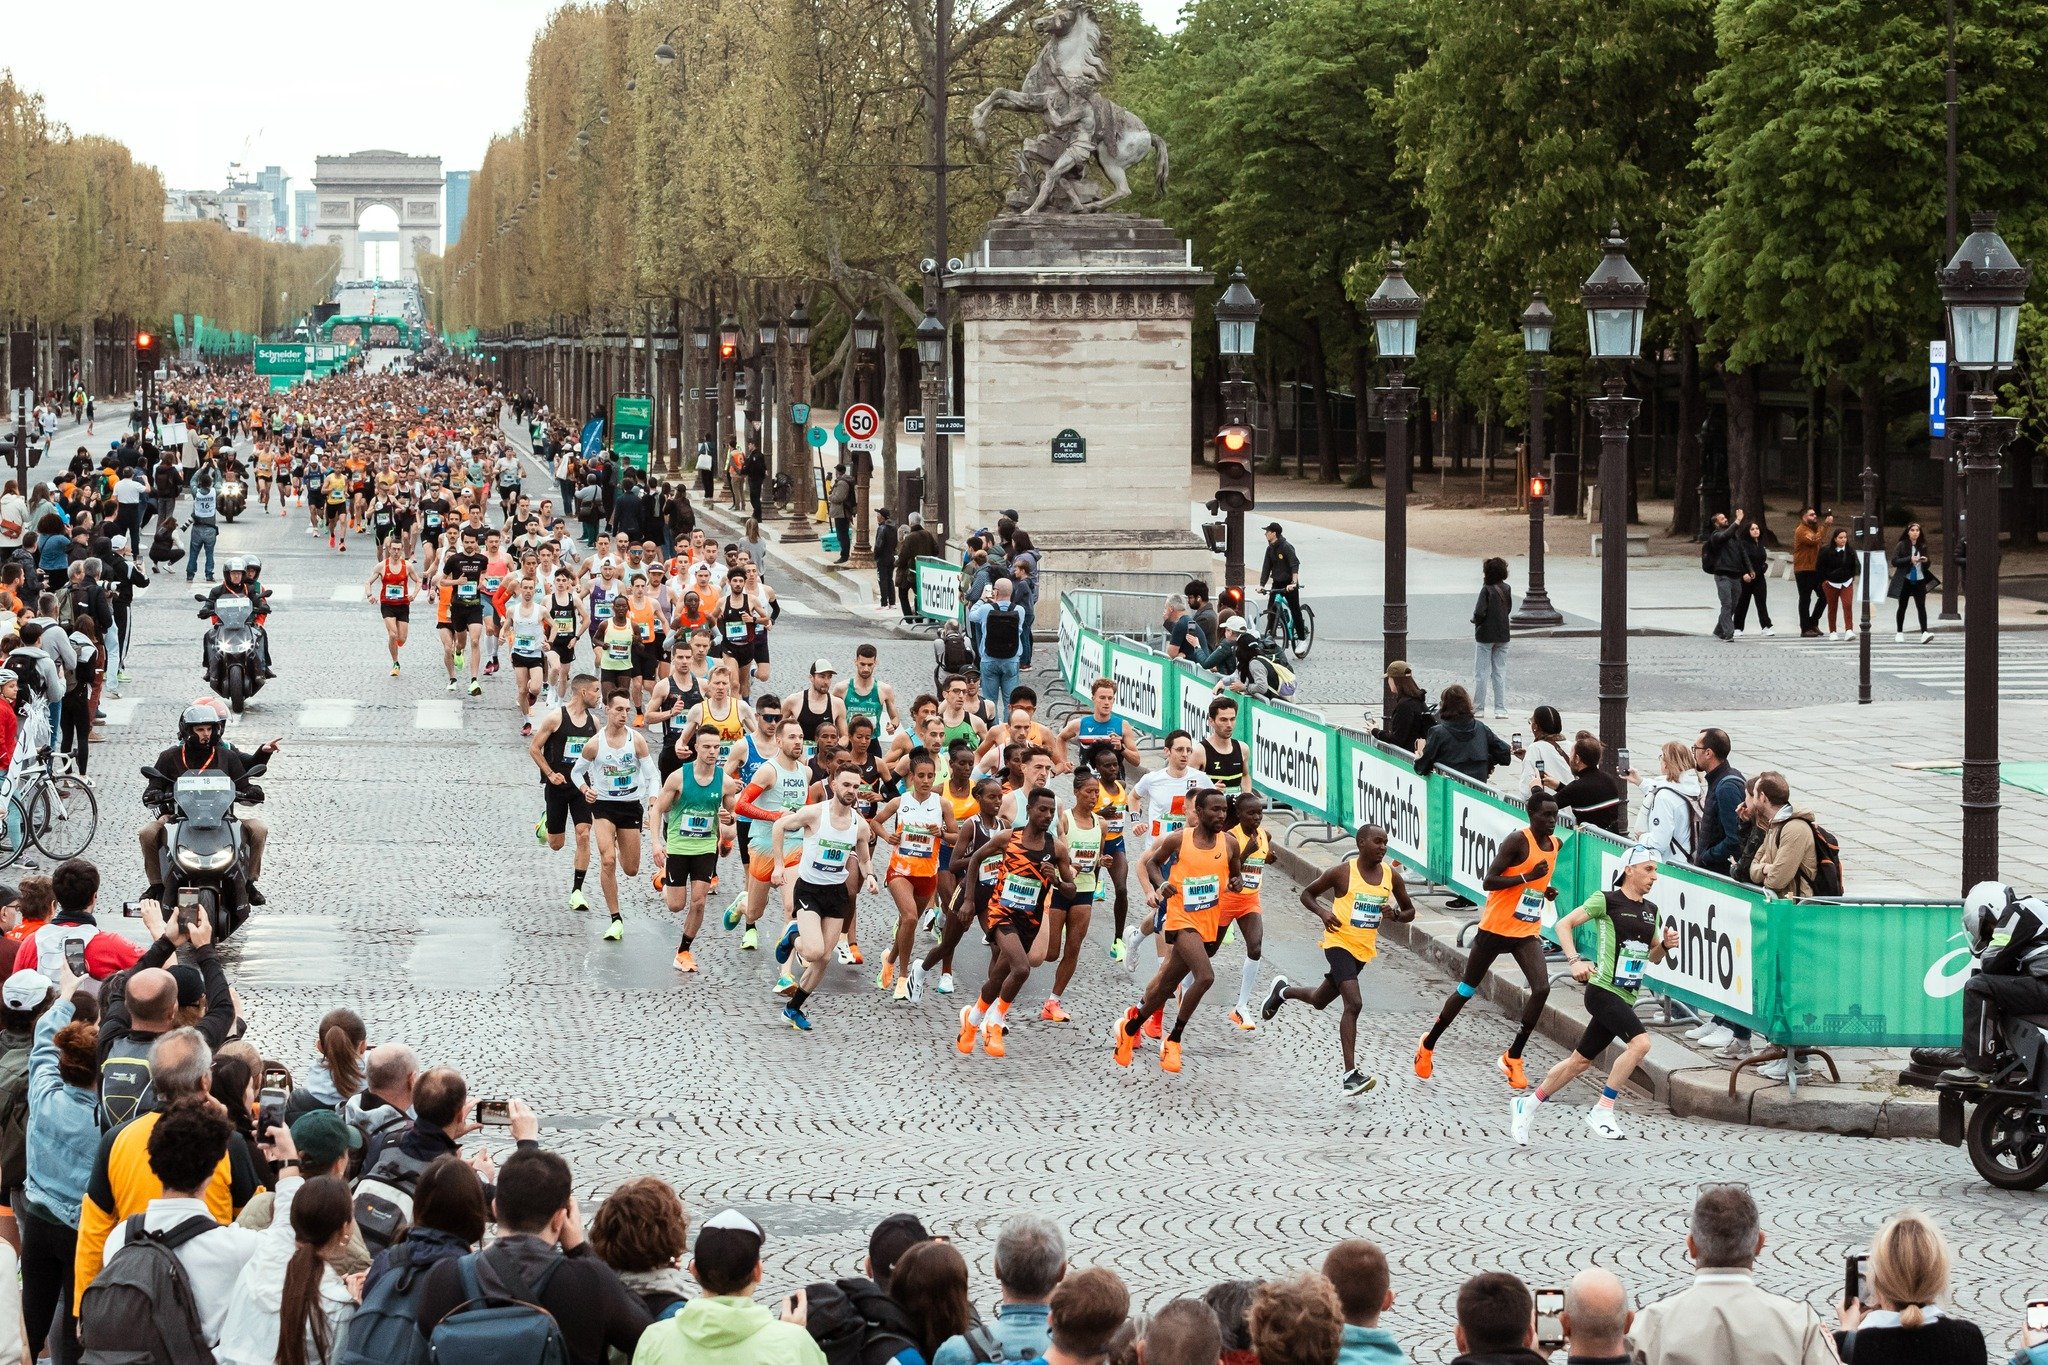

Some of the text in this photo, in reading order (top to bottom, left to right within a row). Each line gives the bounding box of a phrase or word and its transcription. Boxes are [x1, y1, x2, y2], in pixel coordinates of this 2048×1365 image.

[259, 349, 301, 363] Schneider
[1930, 367, 1940, 415] P
[852, 415, 872, 431] 50
[621, 429, 643, 440] Km 1
[1114, 658, 1156, 719] franceinfo
[1256, 719, 1319, 796] franceinfo
[783, 779, 804, 787] HOKA
[1357, 761, 1420, 850] franceinfo
[692, 817, 705, 826] 102
[827, 849, 841, 859] 198
[1189, 884, 1213, 894] KIPTOO
